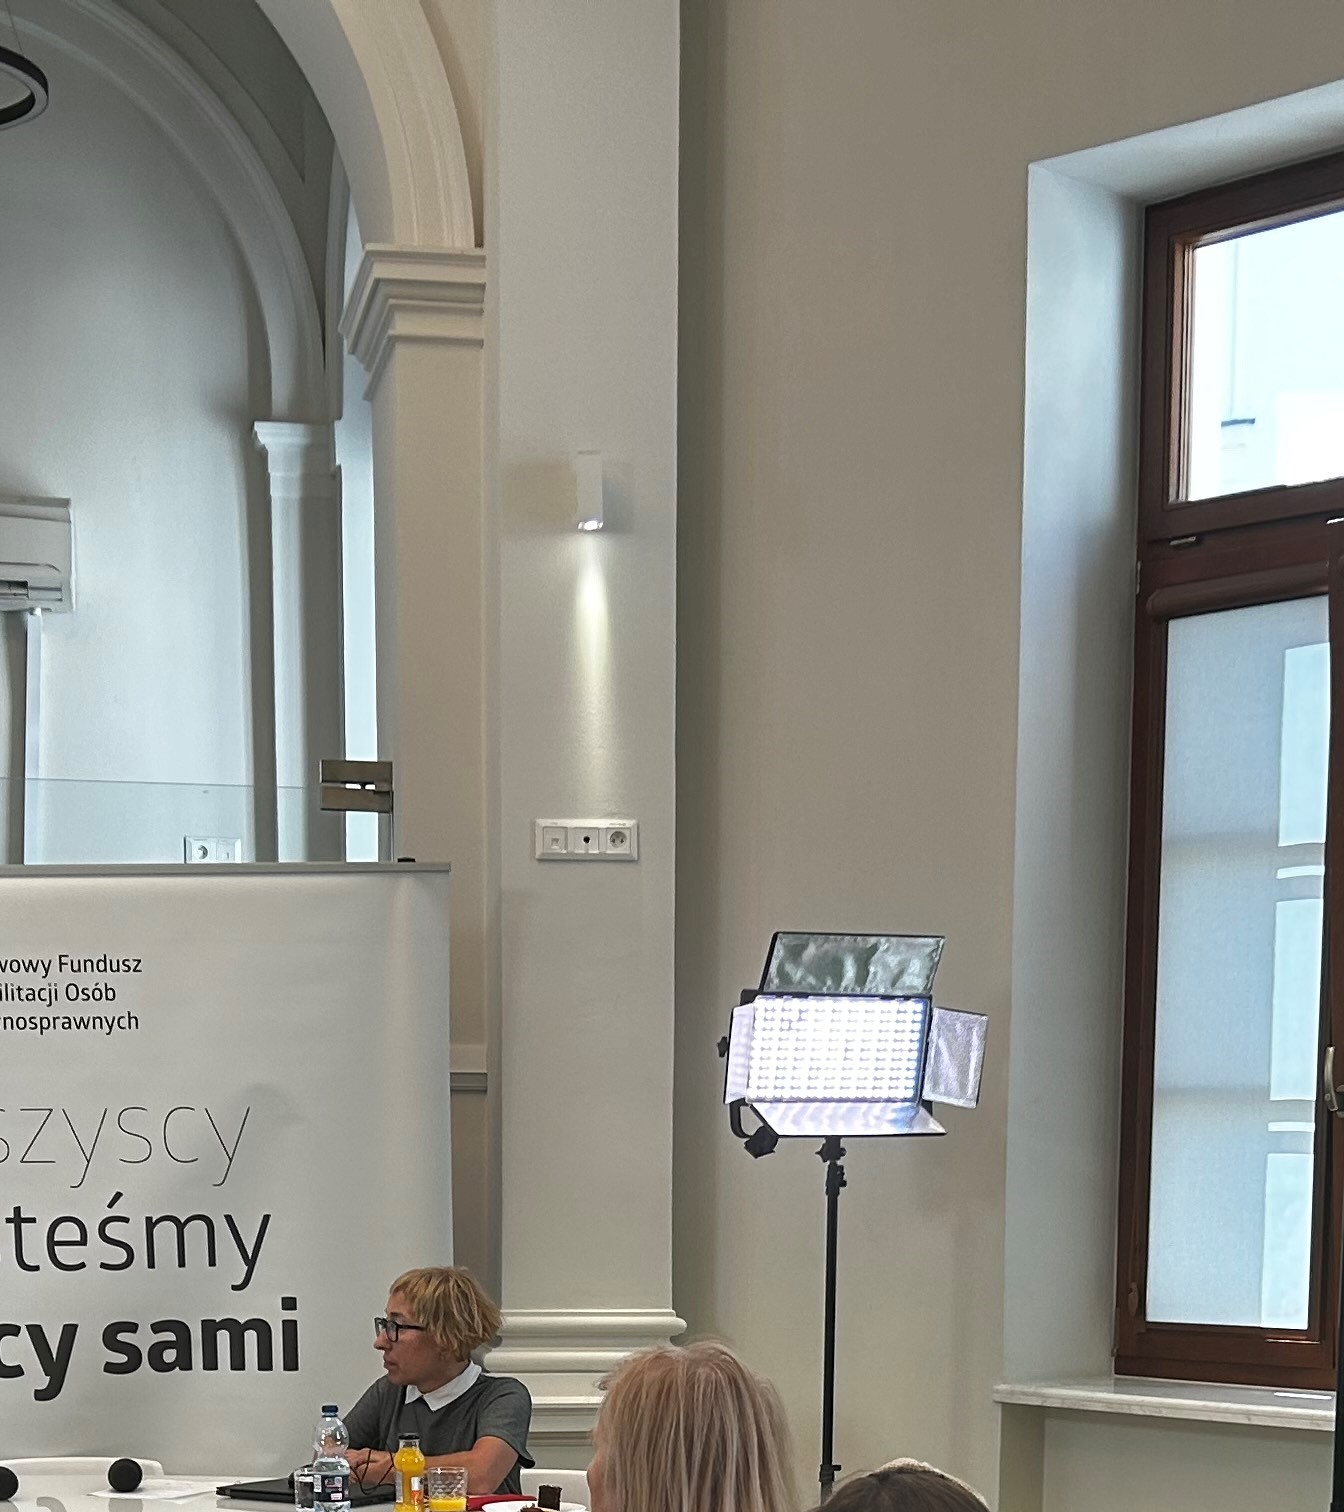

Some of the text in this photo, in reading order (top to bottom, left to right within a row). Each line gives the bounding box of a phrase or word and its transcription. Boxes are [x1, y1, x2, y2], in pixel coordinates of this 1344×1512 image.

[59, 954, 143, 973] Fundusz
[65, 982, 117, 1002] Osób
[101, 1296, 300, 1374] sami
